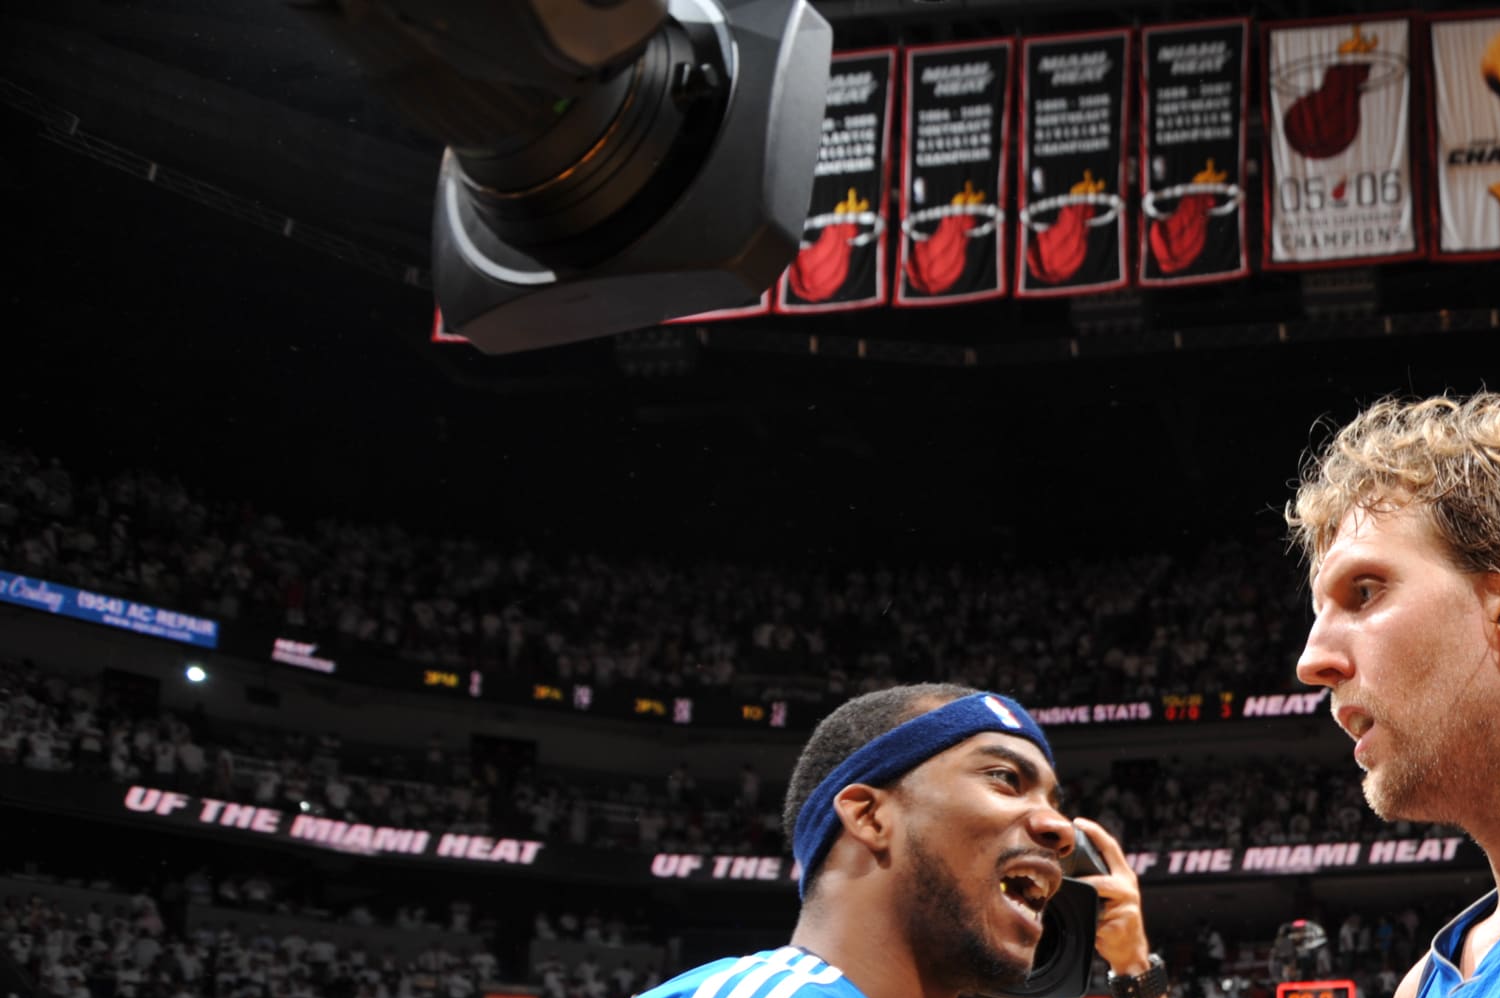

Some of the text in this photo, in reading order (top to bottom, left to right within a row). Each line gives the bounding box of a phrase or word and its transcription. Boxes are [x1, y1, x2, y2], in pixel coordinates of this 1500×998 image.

[1280, 170, 1404, 212] 05 06
[1093, 703, 1152, 722] STATS
[1243, 689, 1331, 718] HEAT
[200, 798, 281, 833] THE
[290, 814, 430, 855] MIAMI
[437, 833, 544, 865] HEAT
[712, 855, 782, 880] THE
[1168, 848, 1233, 874] THE
[1242, 842, 1360, 872] MIAMI
[1369, 837, 1464, 866] HEAT
